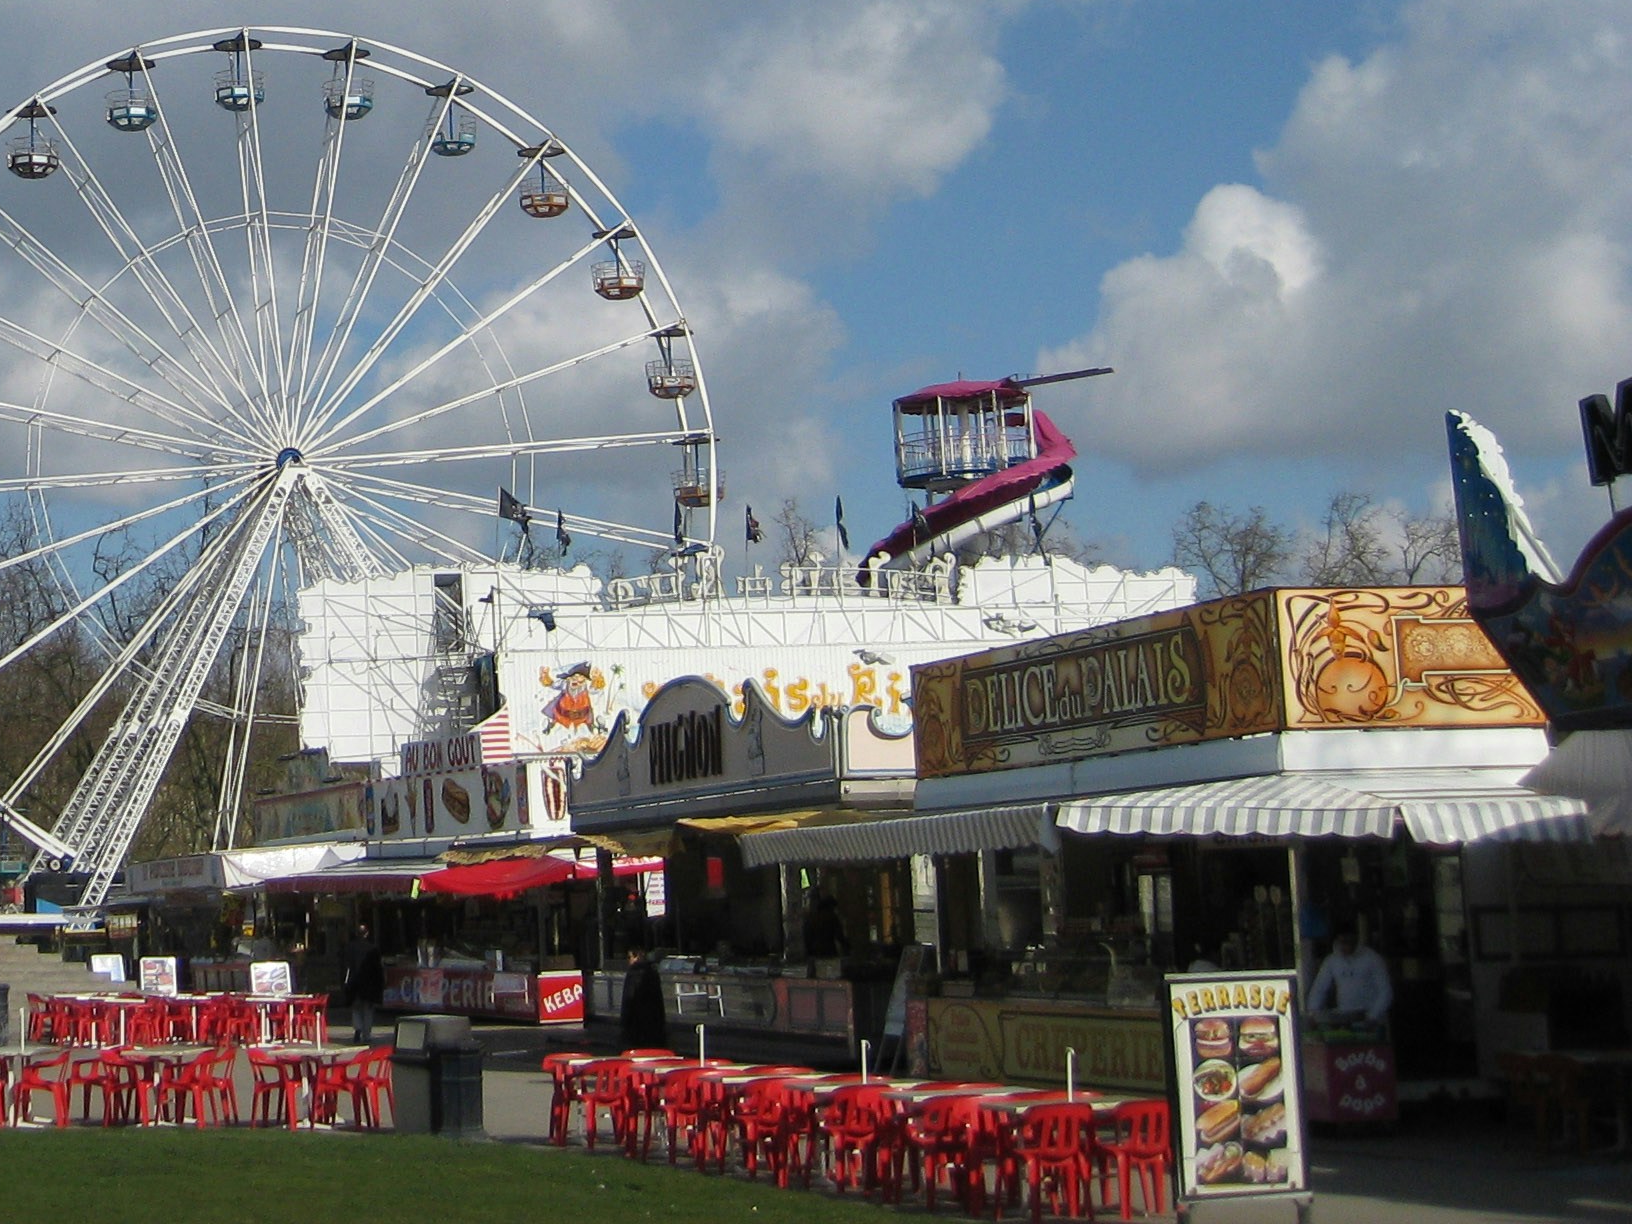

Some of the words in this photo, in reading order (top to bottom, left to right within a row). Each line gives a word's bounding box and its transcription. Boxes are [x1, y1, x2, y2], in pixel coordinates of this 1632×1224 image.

[1578, 376, 1632, 487] M
[846, 663, 906, 714] Ri
[1056, 686, 1083, 721] du
[1078, 632, 1192, 715] PALAIS
[405, 743, 418, 774] AU
[423, 740, 442, 770] BON
[447, 734, 476, 767] GOUT
[649, 703, 723, 785] MIGNON
[1171, 983, 1291, 1019] TERRASSE
